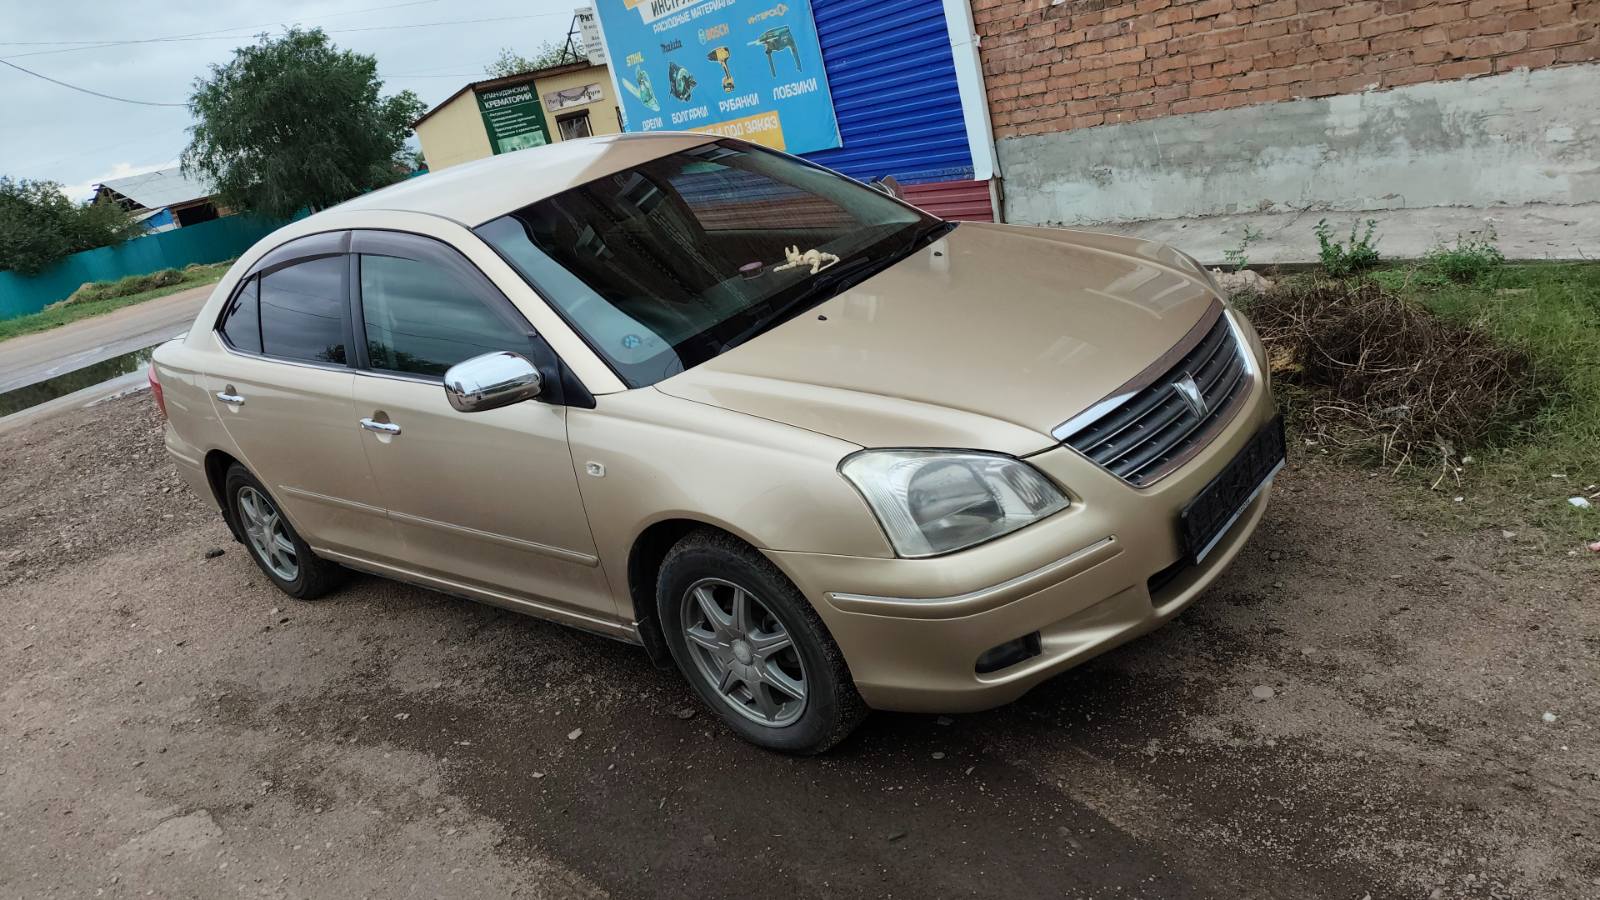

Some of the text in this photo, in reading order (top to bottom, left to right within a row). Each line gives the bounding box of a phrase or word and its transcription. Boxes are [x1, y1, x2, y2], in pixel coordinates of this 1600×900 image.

[773, 77, 818, 100] ЛОБЗИКИ
[484, 92, 533, 109] КРЕМАТОРИЙ
[719, 93, 759, 112] РУБАНКИ
[642, 116, 663, 131] ДРЕЛИ
[671, 105, 709, 124] БОЛГАРКИ
[744, 115, 778, 134] ЗАКАЗ
